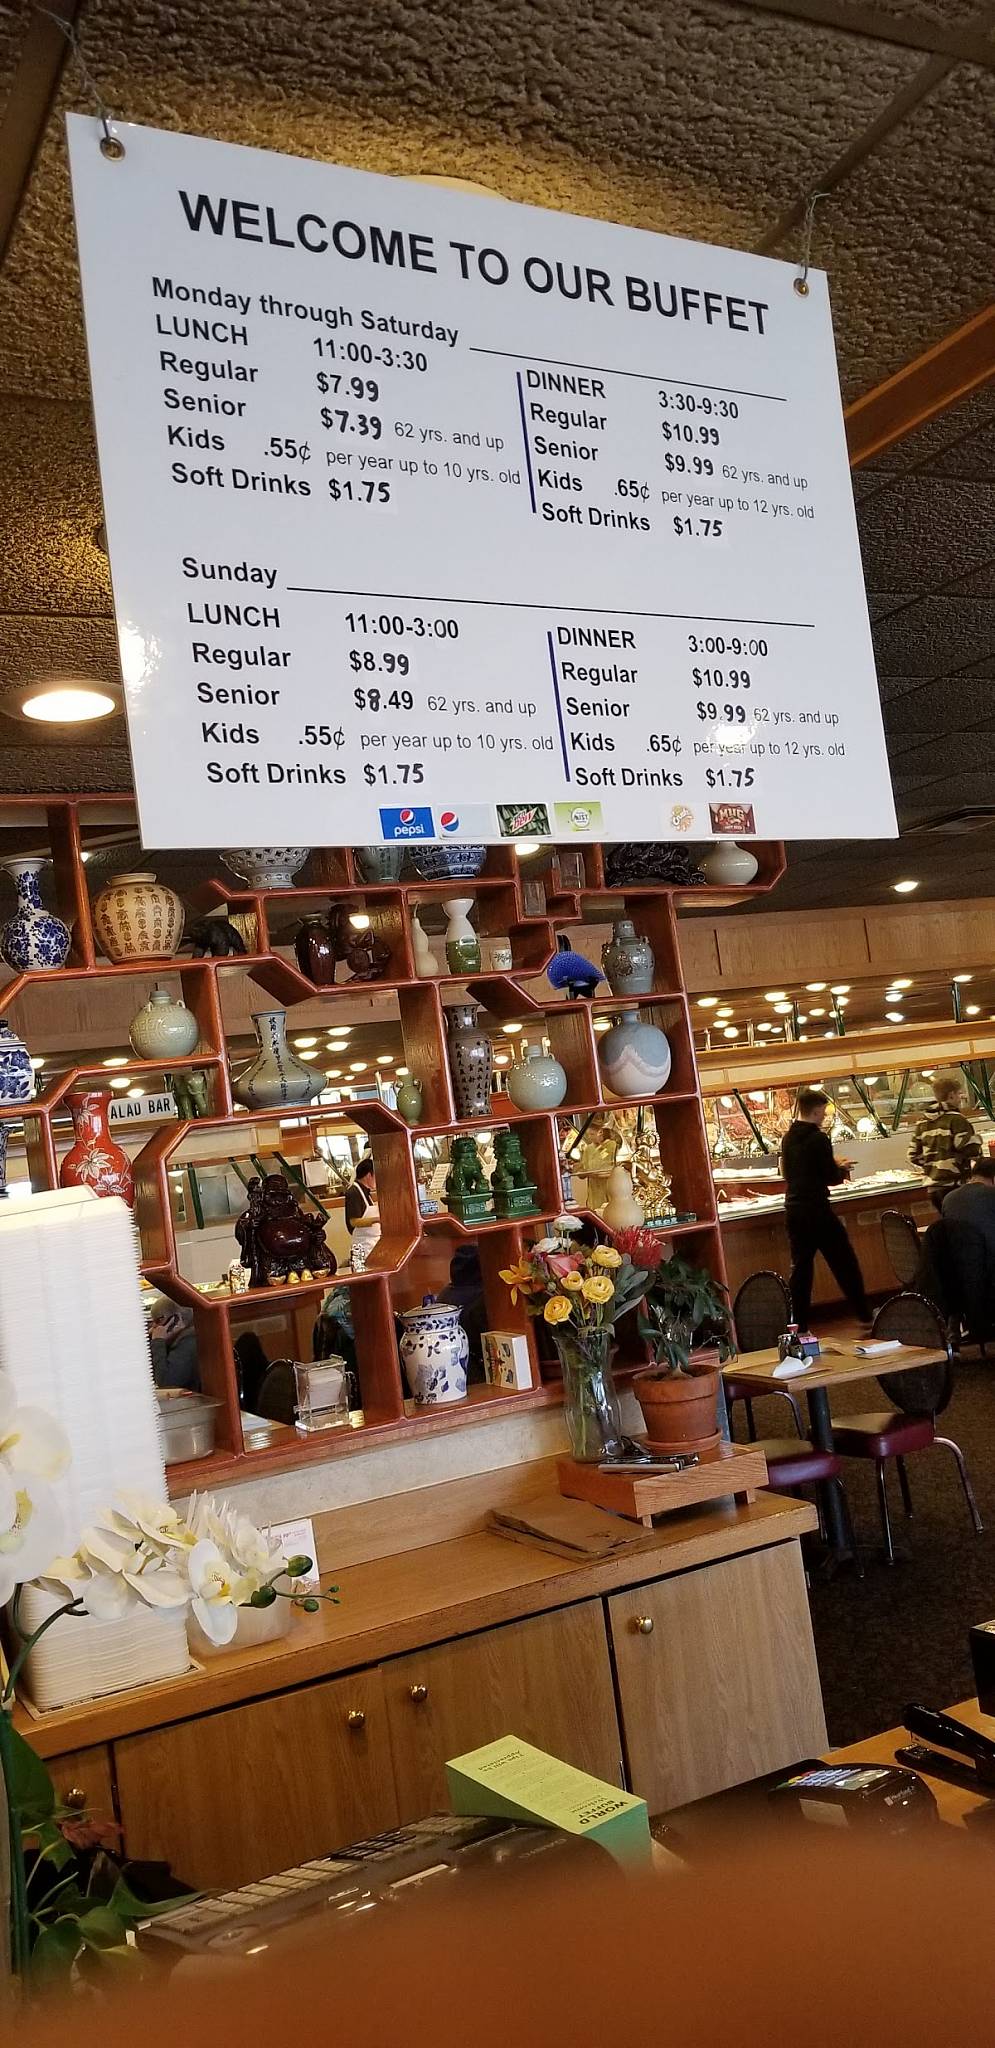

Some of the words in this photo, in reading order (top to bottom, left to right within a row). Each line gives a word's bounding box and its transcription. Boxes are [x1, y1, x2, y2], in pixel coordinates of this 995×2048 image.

[178, 190, 437, 273] WELCOME
[449, 241, 509, 286] TO
[523, 257, 615, 306] OUR
[625, 276, 769, 335] BUFFET
[152, 277, 251, 315] Monday
[259, 295, 353, 329] through
[361, 310, 459, 347] Saturday
[155, 314, 248, 346] LUNCH
[313, 338, 428, 372] 11:00-3:30
[160, 351, 259, 382] Regular
[316, 371, 379, 402] $7.99
[527, 370, 606, 398] DINNER
[658, 391, 739, 419] 3:30-9:30
[164, 388, 247, 417] Senior
[320, 406, 382, 440] $7.39
[394, 422, 415, 438] 62
[419, 428, 447, 443] yrs.
[453, 431, 480, 446] and
[486, 437, 504, 452] up
[531, 402, 607, 430] Regular
[662, 421, 720, 446] $10.99
[168, 425, 226, 451] Kids
[263, 437, 311, 465] .55¢
[326, 452, 353, 467] per
[358, 455, 394, 470] year
[399, 460, 418, 476] up
[423, 460, 438, 475] to
[443, 462, 462, 478] 10
[468, 466, 494, 482] yrs.
[499, 469, 520, 485] old
[534, 436, 599, 461] Senior
[664, 452, 714, 477] $9.99
[722, 465, 739, 479] 62
[742, 470, 764, 484] yrs.
[768, 473, 789, 487] and
[793, 478, 808, 491] up
[172, 463, 224, 487] Soft
[232, 469, 311, 496] Drinks
[328, 478, 391, 503] $1.75
[538, 469, 583, 492] Kids
[614, 479, 650, 503] .65¢
[661, 491, 683, 504] per
[687, 494, 714, 508] year
[718, 498, 734, 512] up
[738, 498, 750, 511] to
[753, 499, 769, 513] 12
[772, 503, 794, 518] yrs.
[797, 505, 815, 519] old
[542, 503, 583, 525] Soft
[588, 507, 651, 531] Drinks
[673, 516, 723, 537] $1.75
[182, 557, 278, 589] Sunday
[187, 603, 281, 628] LUNCH
[344, 612, 459, 639] 11:00-3:00
[192, 642, 291, 670] Regular
[349, 649, 410, 676] $8.99
[557, 627, 637, 650] DINNER
[687, 635, 768, 657] 3:00-9:00
[561, 662, 638, 687] Regular
[692, 667, 751, 689] $10.99
[197, 682, 280, 706] Senior
[354, 688, 414, 712] $8.49
[427, 696, 447, 712] 62
[452, 700, 480, 715] yrs.
[485, 699, 513, 714] and
[517, 702, 537, 717] up
[566, 697, 630, 718] Senior
[696, 701, 746, 723] $9.99
[754, 708, 770, 722] 62
[773, 711, 795, 726] yrs.
[799, 711, 820, 724] and
[824, 714, 839, 728] up
[202, 722, 260, 745] Kids
[298, 725, 346, 751] .55¢
[360, 735, 388, 750] per
[392, 735, 427, 751] year
[432, 736, 452, 752] up
[457, 734, 472, 749] to
[477, 735, 496, 750] 10
[500, 737, 527, 753] yrs.
[532, 735, 554, 751] old
[571, 732, 615, 752] Kids
[646, 735, 682, 756] .65¢
[693, 742, 715, 757] per
[750, 743, 766, 757] up
[769, 742, 780, 755] to
[785, 742, 800, 755] 12
[803, 744, 825, 758] yrs.
[828, 742, 845, 756] old
[207, 762, 260, 784] Soft
[267, 763, 347, 785] Drinks
[363, 763, 425, 786] $1.75
[575, 767, 616, 787] Soft
[621, 767, 684, 787] Drinks
[705, 768, 756, 788] $1.75
[394, 824, 426, 837] pepsi
[110, 1102, 141, 1120] ALAD
[148, 1098, 171, 1114] BAR
[580, 1801, 629, 1824] WORLD
